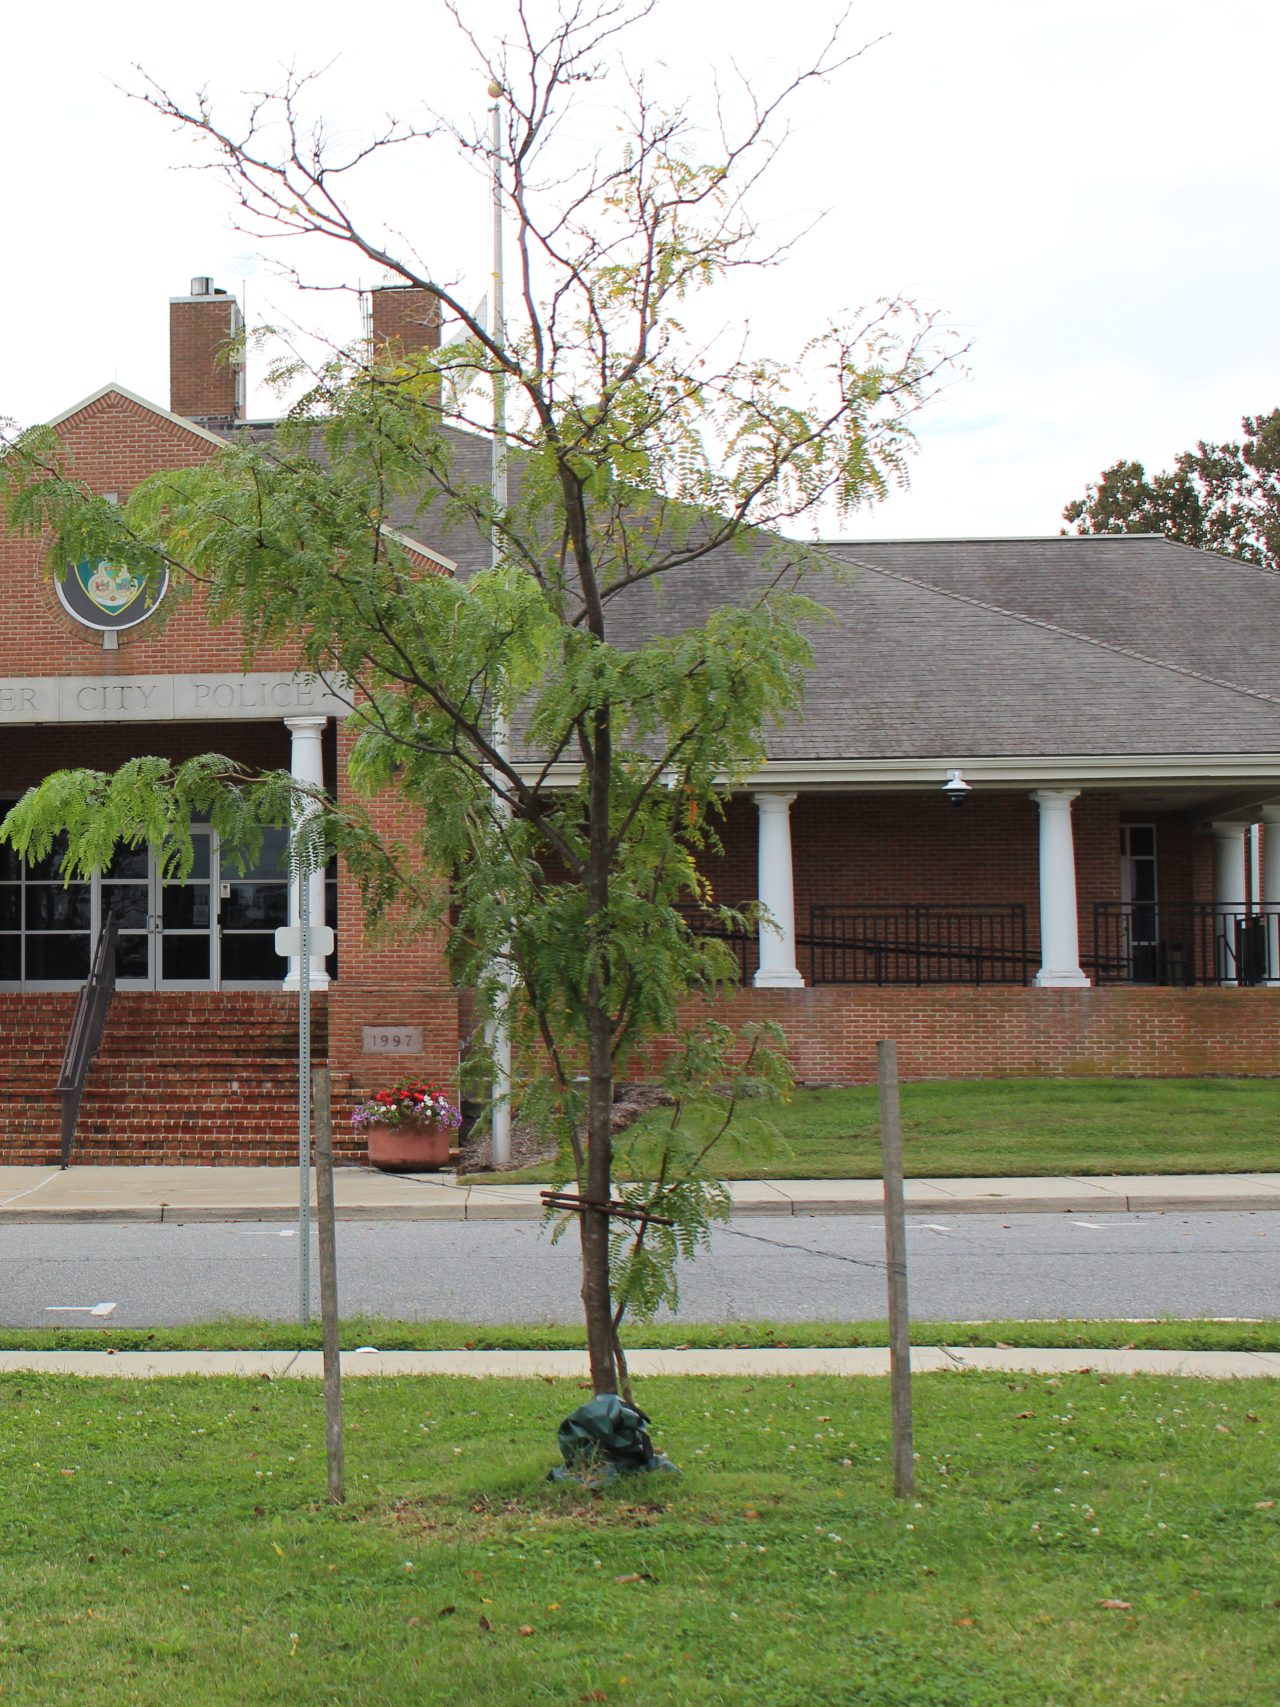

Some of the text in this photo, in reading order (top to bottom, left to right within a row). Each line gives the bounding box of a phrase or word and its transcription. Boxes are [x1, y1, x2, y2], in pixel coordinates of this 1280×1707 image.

[77, 685, 159, 711] CITY
[193, 682, 315, 708] POLICE
[373, 1034, 413, 1048] 1997
